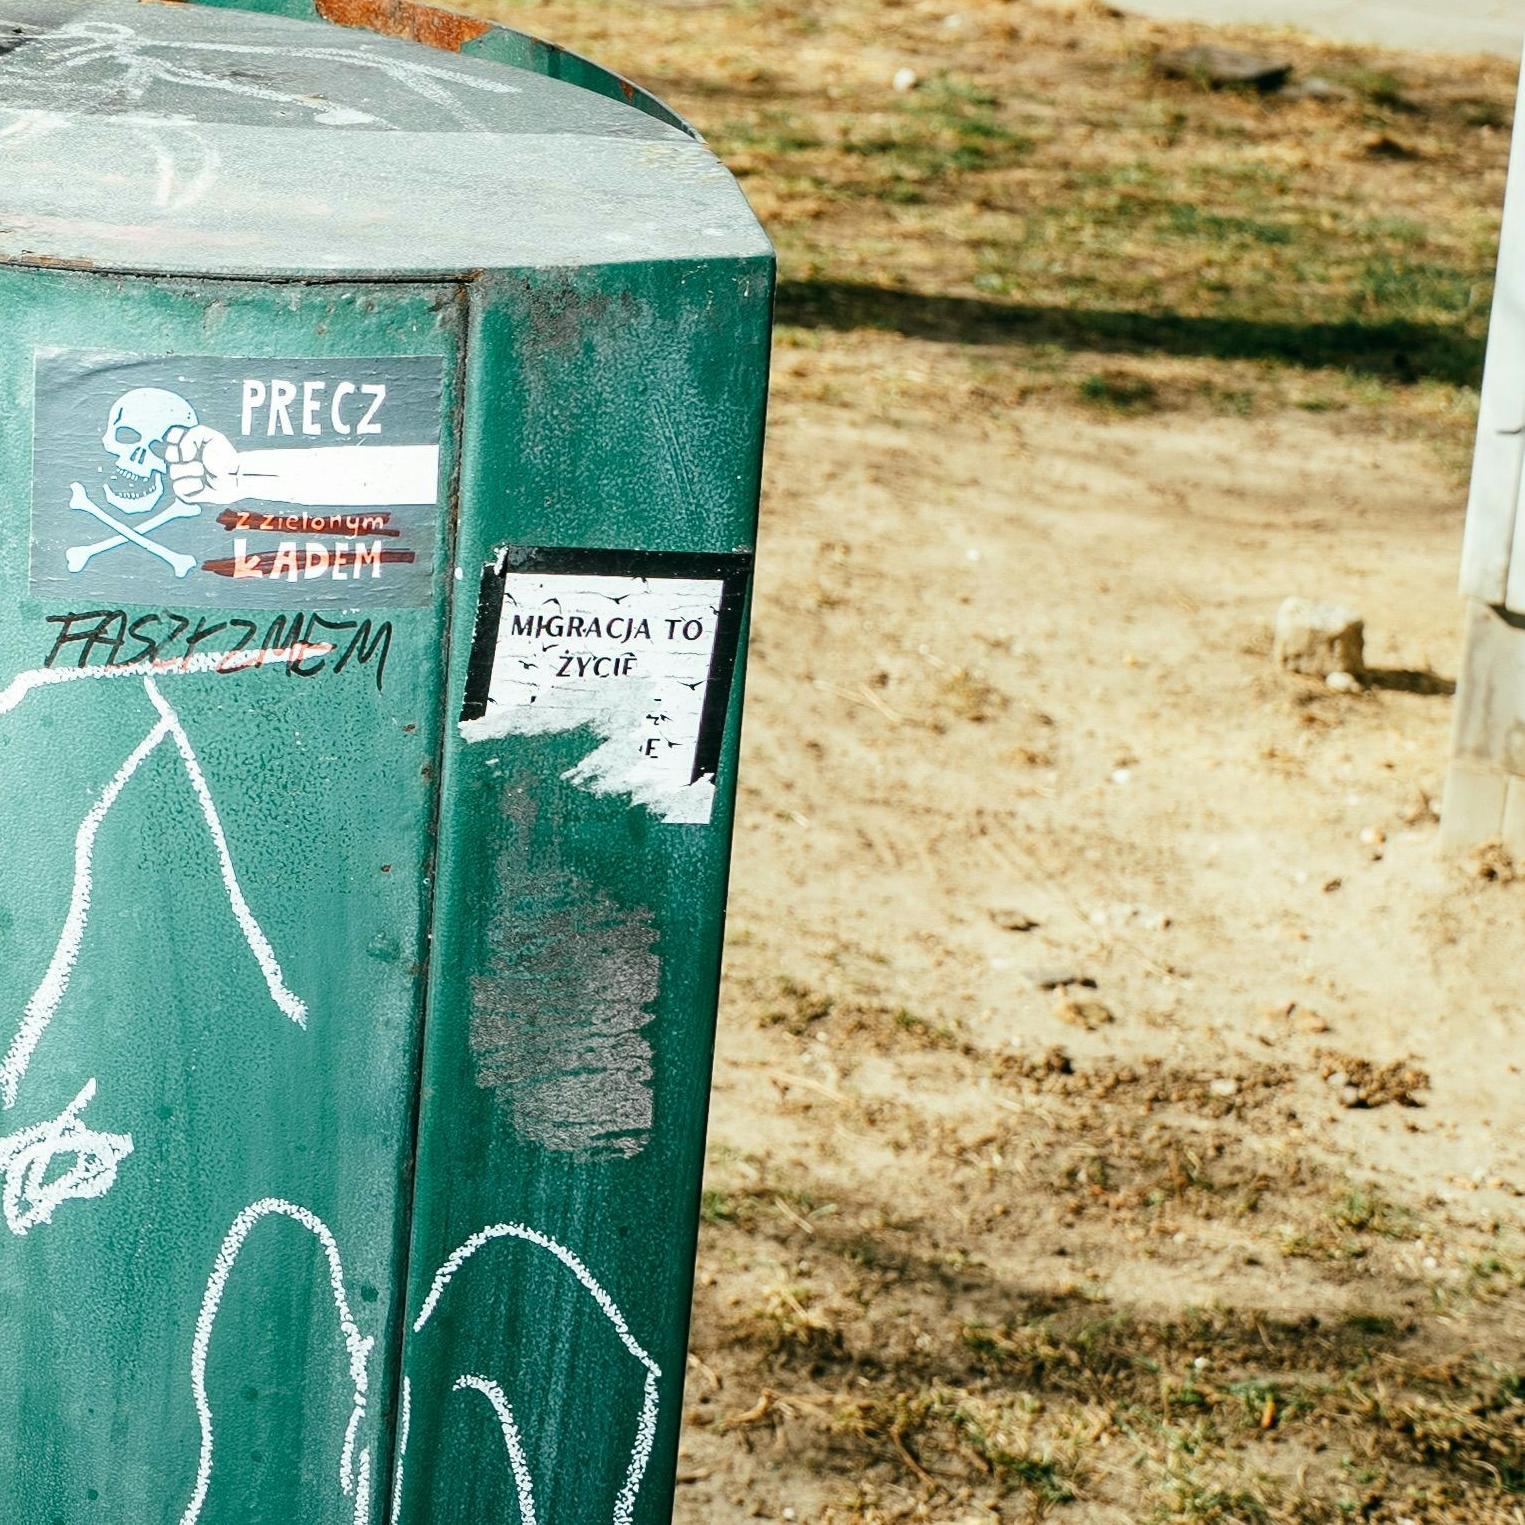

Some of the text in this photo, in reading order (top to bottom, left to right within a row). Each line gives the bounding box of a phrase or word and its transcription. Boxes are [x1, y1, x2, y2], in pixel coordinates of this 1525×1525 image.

[240, 379, 388, 437] PRECZ
[259, 511, 385, 539] zielonym
[233, 538, 383, 583] ŁADEM
[511, 614, 704, 644] MIGRACJA TO
